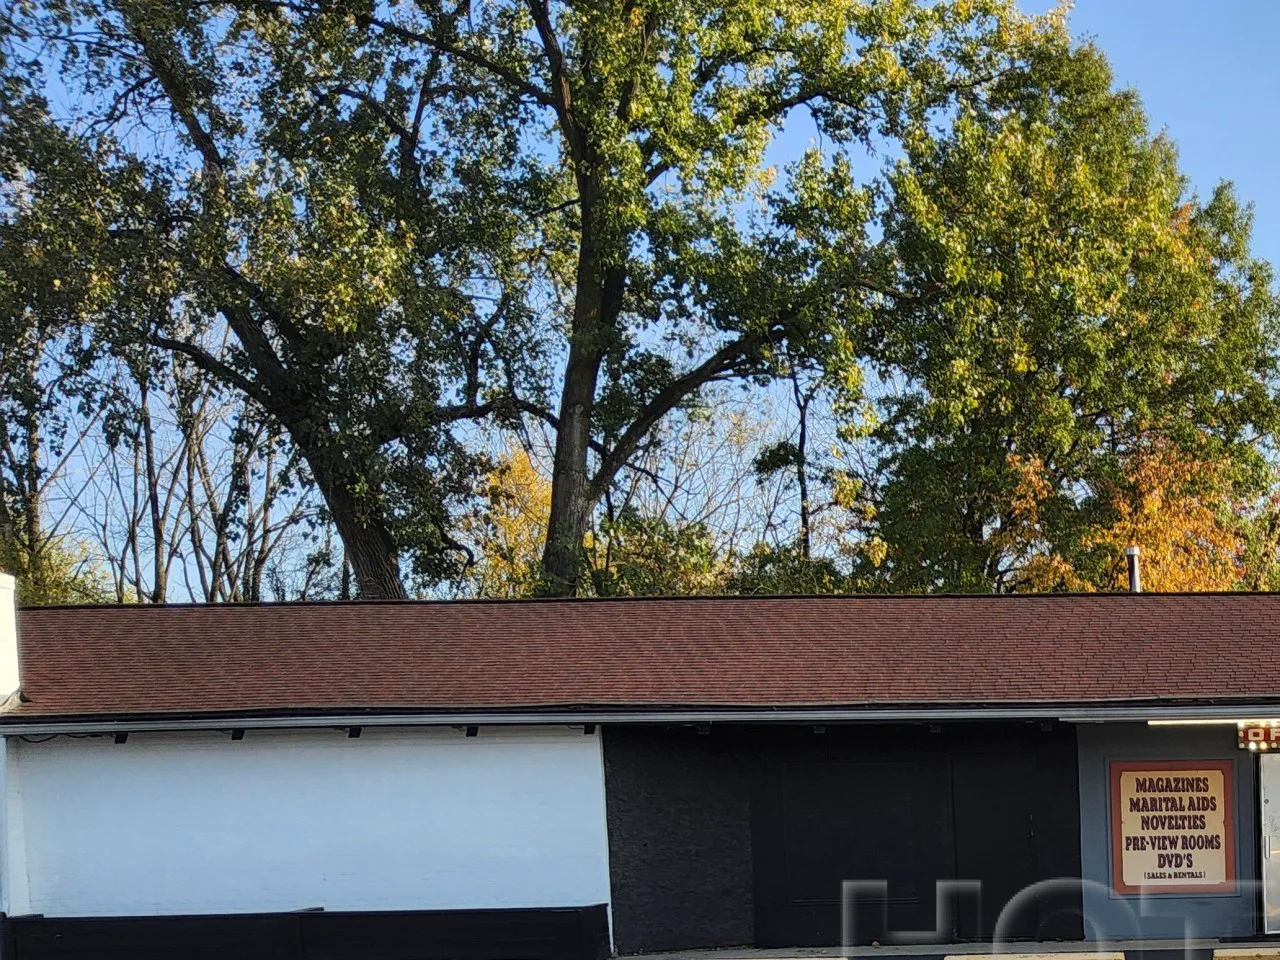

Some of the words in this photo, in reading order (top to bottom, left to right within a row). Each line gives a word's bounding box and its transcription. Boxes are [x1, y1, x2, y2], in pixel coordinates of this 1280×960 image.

[1135, 777, 1209, 793] MAGAZINES
[1129, 796, 1185, 812] MARITAL
[1187, 796, 1217, 811] AIDS
[1140, 814, 1206, 830] NOVELTIES
[1124, 834, 1179, 851] PRE-VIEW
[1181, 834, 1221, 850] ROOMS
[1157, 853, 1193, 869] DVD'S
[1144, 871, 1167, 880] (SALES
[1173, 870, 1206, 879] RENTALS)
